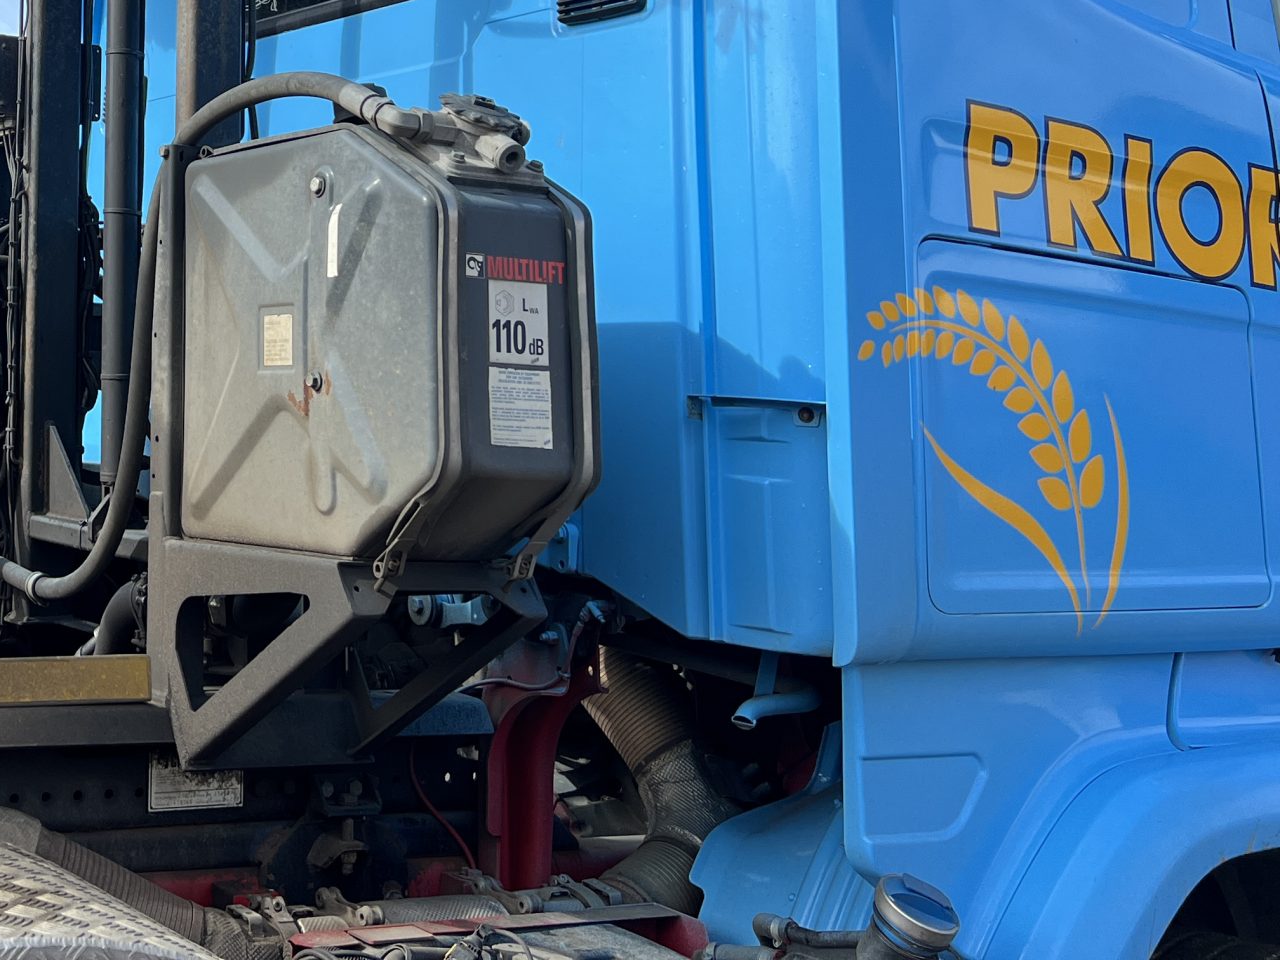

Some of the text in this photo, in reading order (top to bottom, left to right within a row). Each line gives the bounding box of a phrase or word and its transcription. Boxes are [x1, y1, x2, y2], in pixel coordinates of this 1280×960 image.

[487, 255, 566, 285] MULTILIFT
[492, 319, 544, 356] 110 dB
